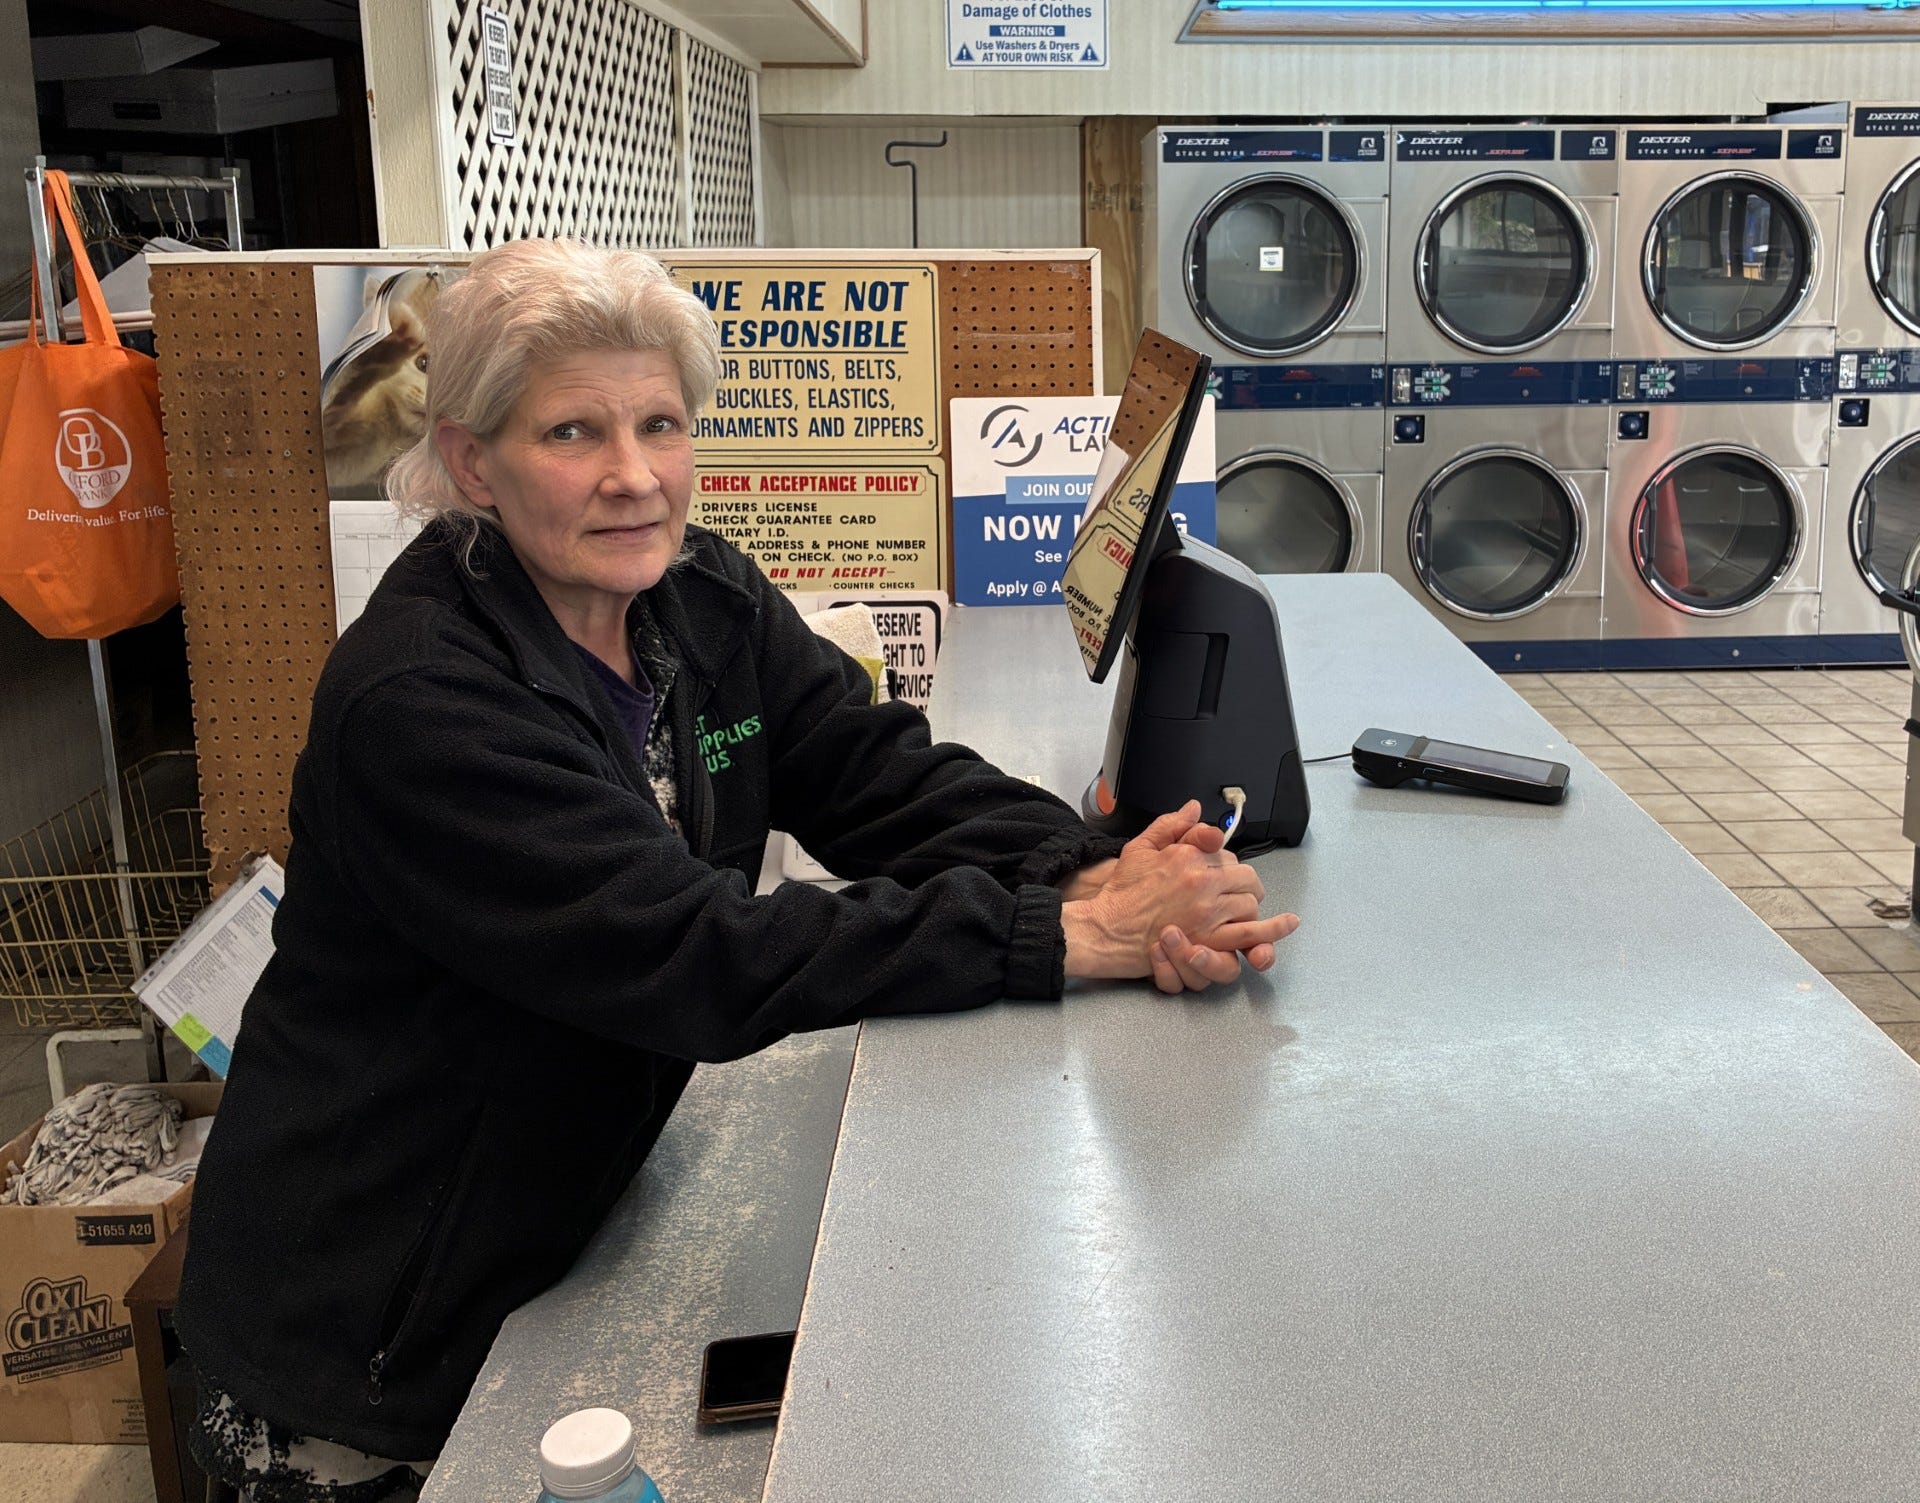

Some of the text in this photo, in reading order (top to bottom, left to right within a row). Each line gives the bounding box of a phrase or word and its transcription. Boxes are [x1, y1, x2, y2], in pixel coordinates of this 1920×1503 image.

[963, 3, 1092, 20] Damage of Clothes
[1000, 26, 1056, 36] WARNING
[975, 41, 1080, 52] Use Washers & Dryers
[982, 53, 1073, 62] AT YOUR OWN RISK
[1866, 112, 1919, 121] DEXTER
[1176, 138, 1230, 146] DEXTER
[1410, 137, 1464, 145] DEXTER
[1639, 136, 1692, 144] DEXTER
[692, 280, 910, 312] WE ARE NOT
[713, 319, 908, 348] ESPONSIBLE
[718, 359, 902, 382] OR BUTTONS, BELTS,
[716, 387, 896, 411] BUCKLES, ELASTICS,
[690, 416, 924, 438] ORNAMENTS AND ZIPPERS
[1053, 416, 1110, 434] ACTI
[701, 475, 919, 492] CHECK ACCEPTANCE POLICY
[1023, 483, 1060, 497] JOIN
[119, 510, 141, 521] For
[143, 505, 169, 518] life.
[702, 502, 818, 512] DRIVERS LICENSE
[702, 515, 877, 525] CHECK GUARANTEE CARD
[709, 527, 789, 538] ILITARY I.D.
[983, 515, 1062, 542] NOW
[749, 539, 805, 550] ADDRESS
[811, 540, 820, 550] &
[827, 540, 869, 550] PHONE
[876, 540, 926, 550] NUMBER
[761, 552, 781, 562] ON
[788, 552, 836, 562] CHECK.
[842, 553, 863, 563] (NO
[867, 553, 887, 563] P.O.
[892, 553, 919, 563] BOX)
[1035, 550, 1063, 563] See
[769, 567, 789, 578] DO
[796, 567, 826, 578] NOT
[833, 582, 875, 590] COUNTER
[880, 582, 915, 590] CHECKS
[986, 580, 1028, 598] Apply
[1032, 582, 1047, 596] @
[872, 612, 922, 637] ESERVE
[882, 643, 925, 668] GHT TO
[698, 714, 762, 756] PPLIES
[705, 750, 731, 773] US
[88, 1224, 125, 1237] 51655
[128, 1223, 152, 1236] A20
[29, 1284, 81, 1318] OXI
[13, 1302, 106, 1349] CLEAN
